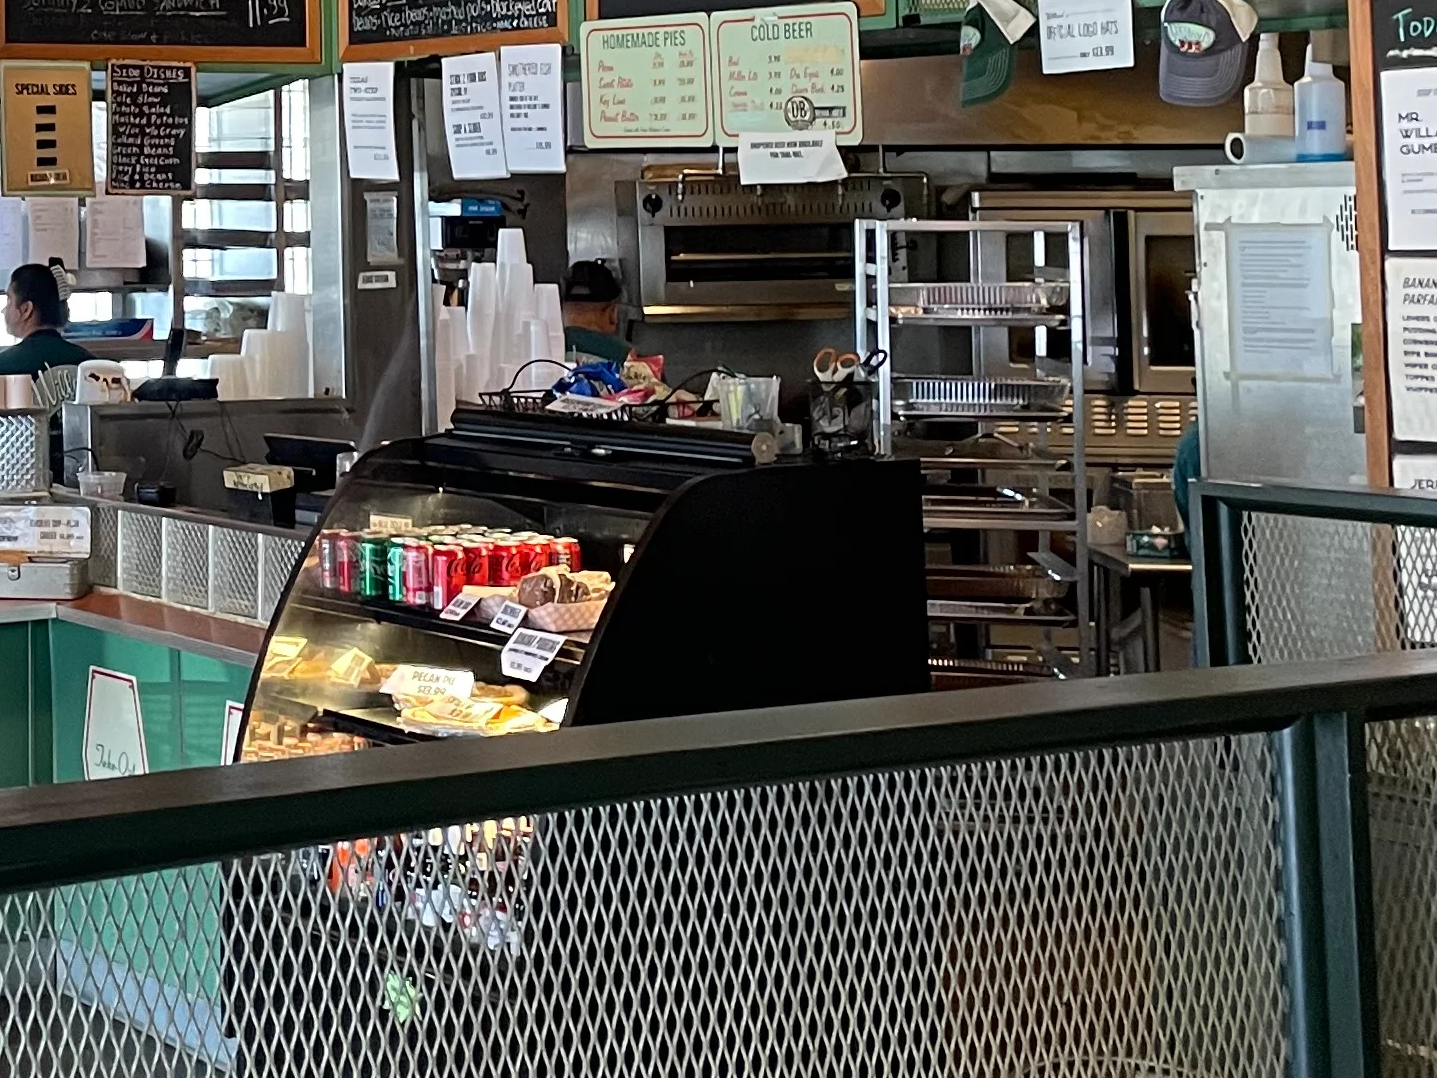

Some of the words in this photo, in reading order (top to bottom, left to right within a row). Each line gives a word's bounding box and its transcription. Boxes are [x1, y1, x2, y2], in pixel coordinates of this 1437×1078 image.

[603, 32, 661, 50] HOMEMADE
[663, 30, 686, 47] PIES
[751, 24, 779, 42] COLD
[784, 22, 813, 40] BEER
[15, 83, 51, 95] SPECIAL
[53, 84, 77, 95] SIDES
